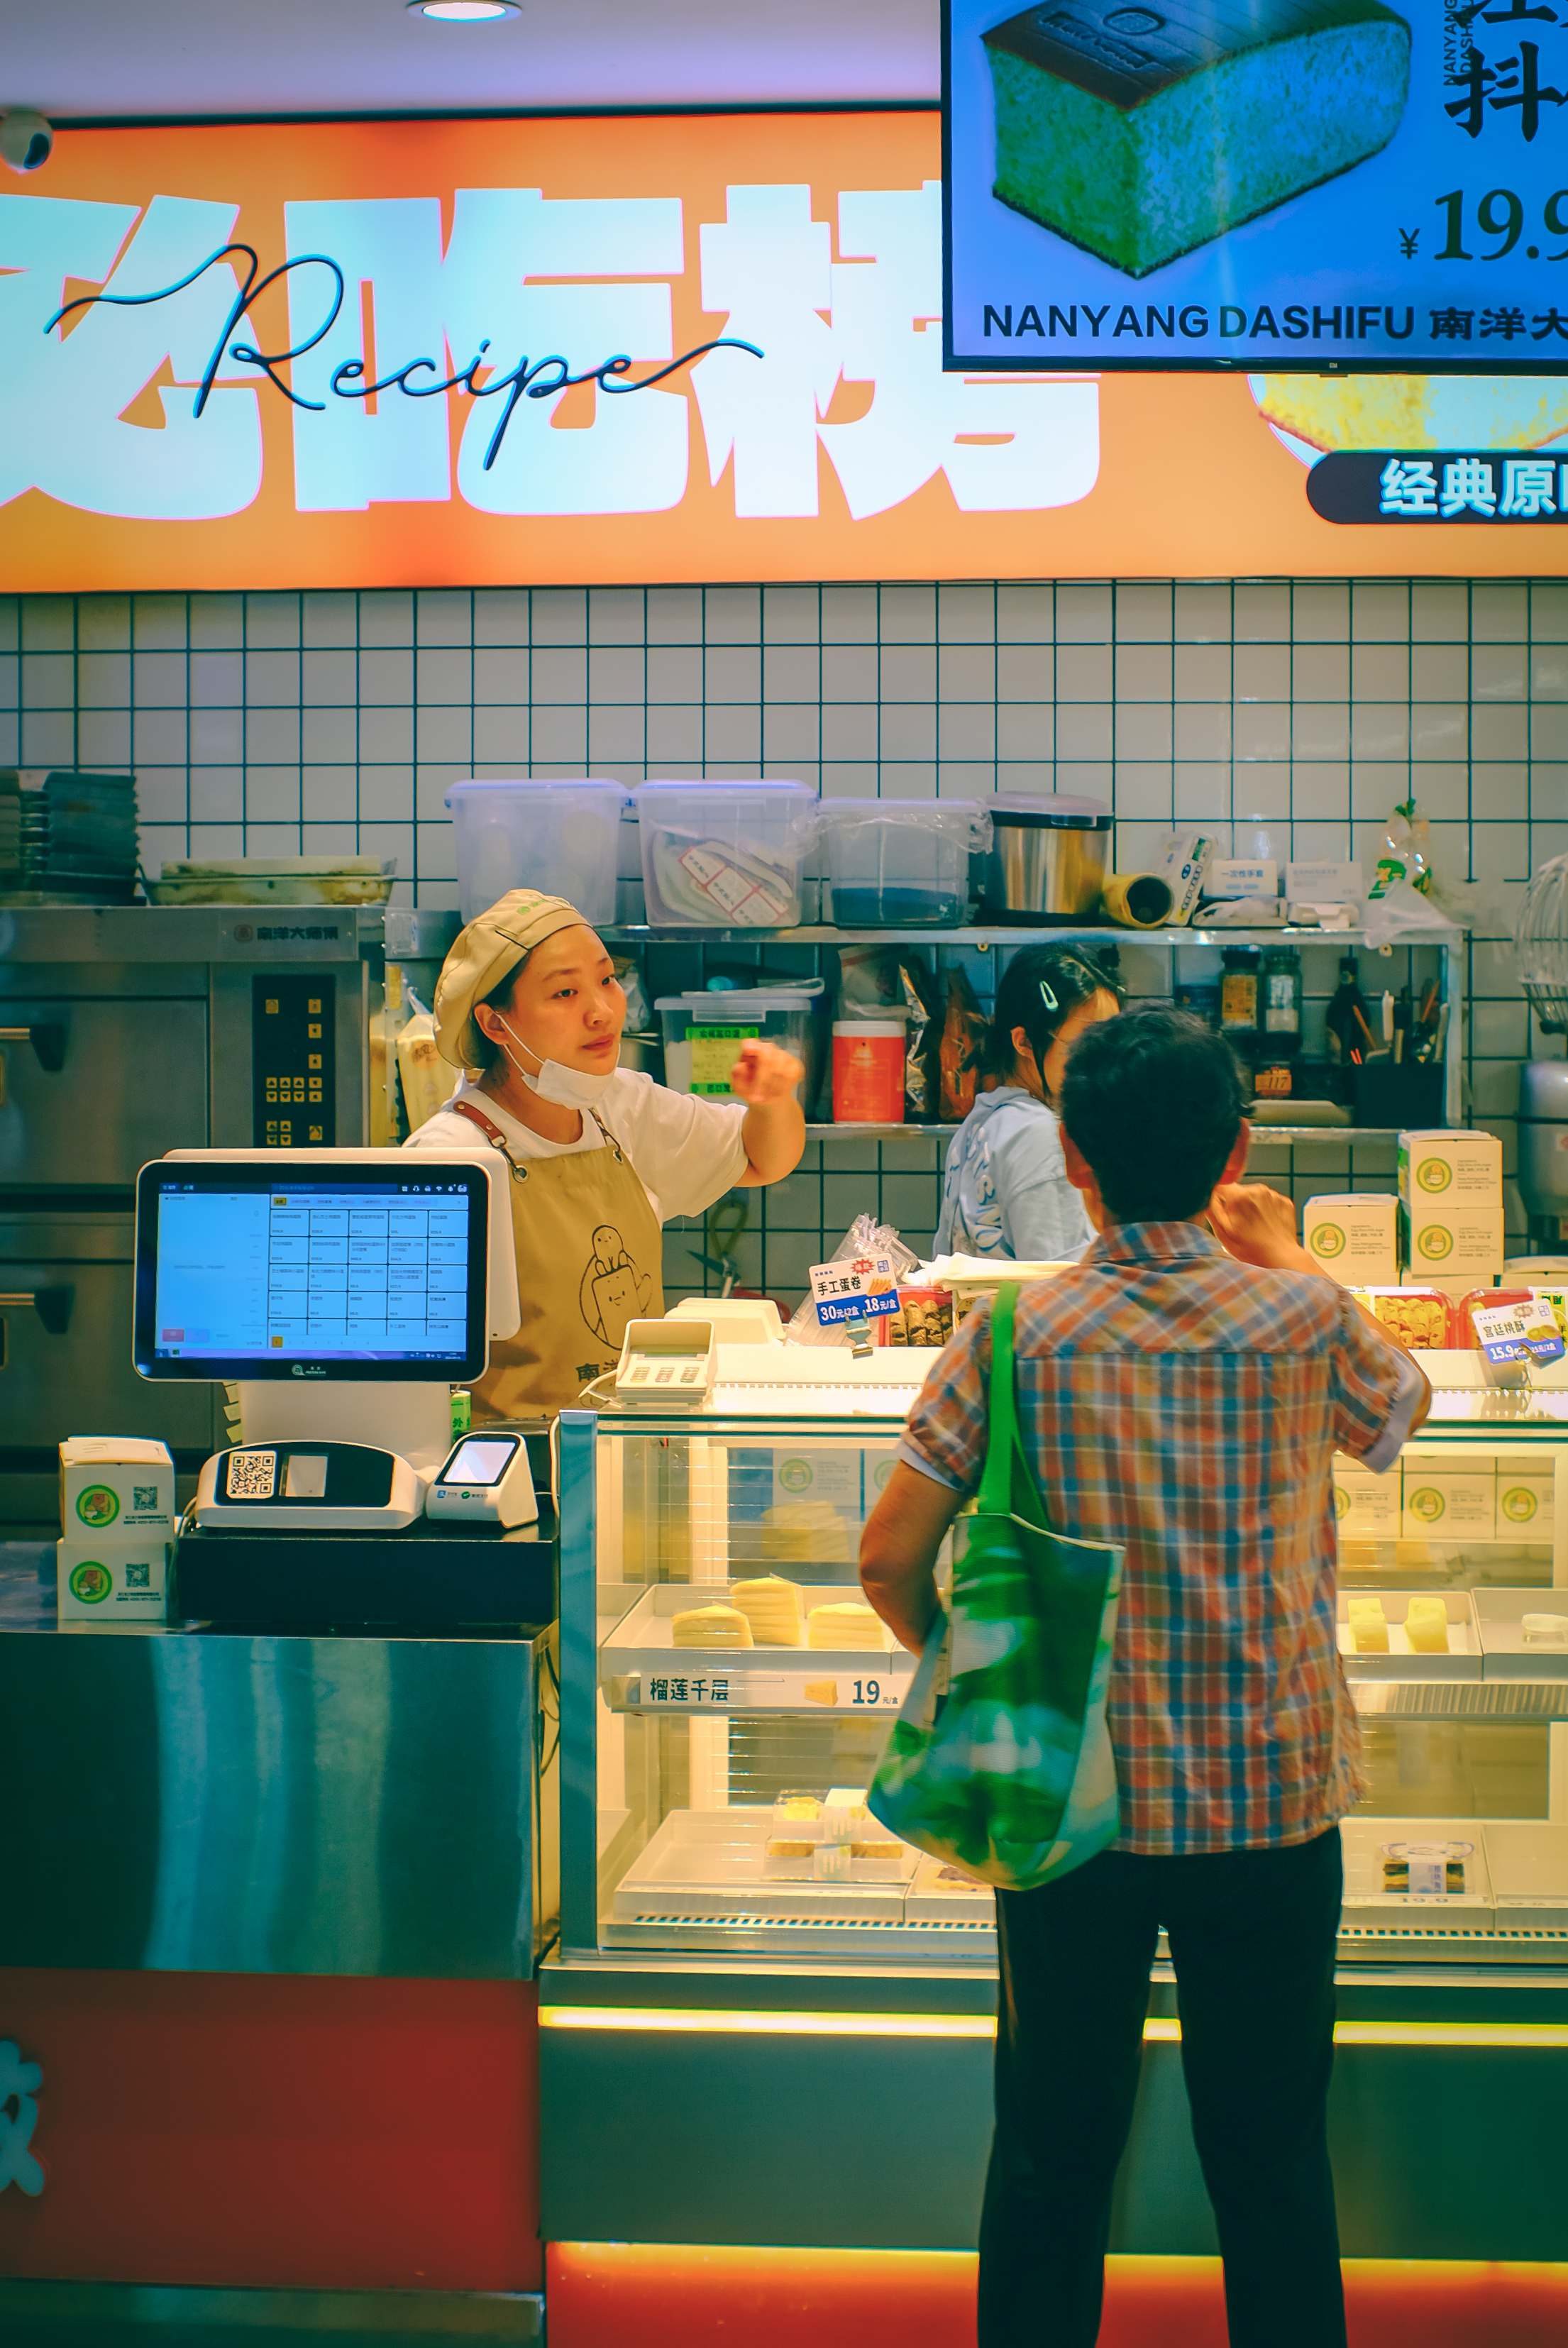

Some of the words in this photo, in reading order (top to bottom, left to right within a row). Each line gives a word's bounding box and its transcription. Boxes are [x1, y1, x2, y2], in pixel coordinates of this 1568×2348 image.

[1444, 40, 1568, 143] 抖
[983, 304, 1210, 338] NANYANG
[1219, 304, 1415, 338] DASHIFU
[1428, 307, 1568, 341] 南洋大
[44, 243, 763, 470] Recipe
[1379, 458, 1568, 519] 经典原
[817, 1276, 861, 1296] 手工蛋卷
[650, 1677, 729, 1702] 榴莲千层
